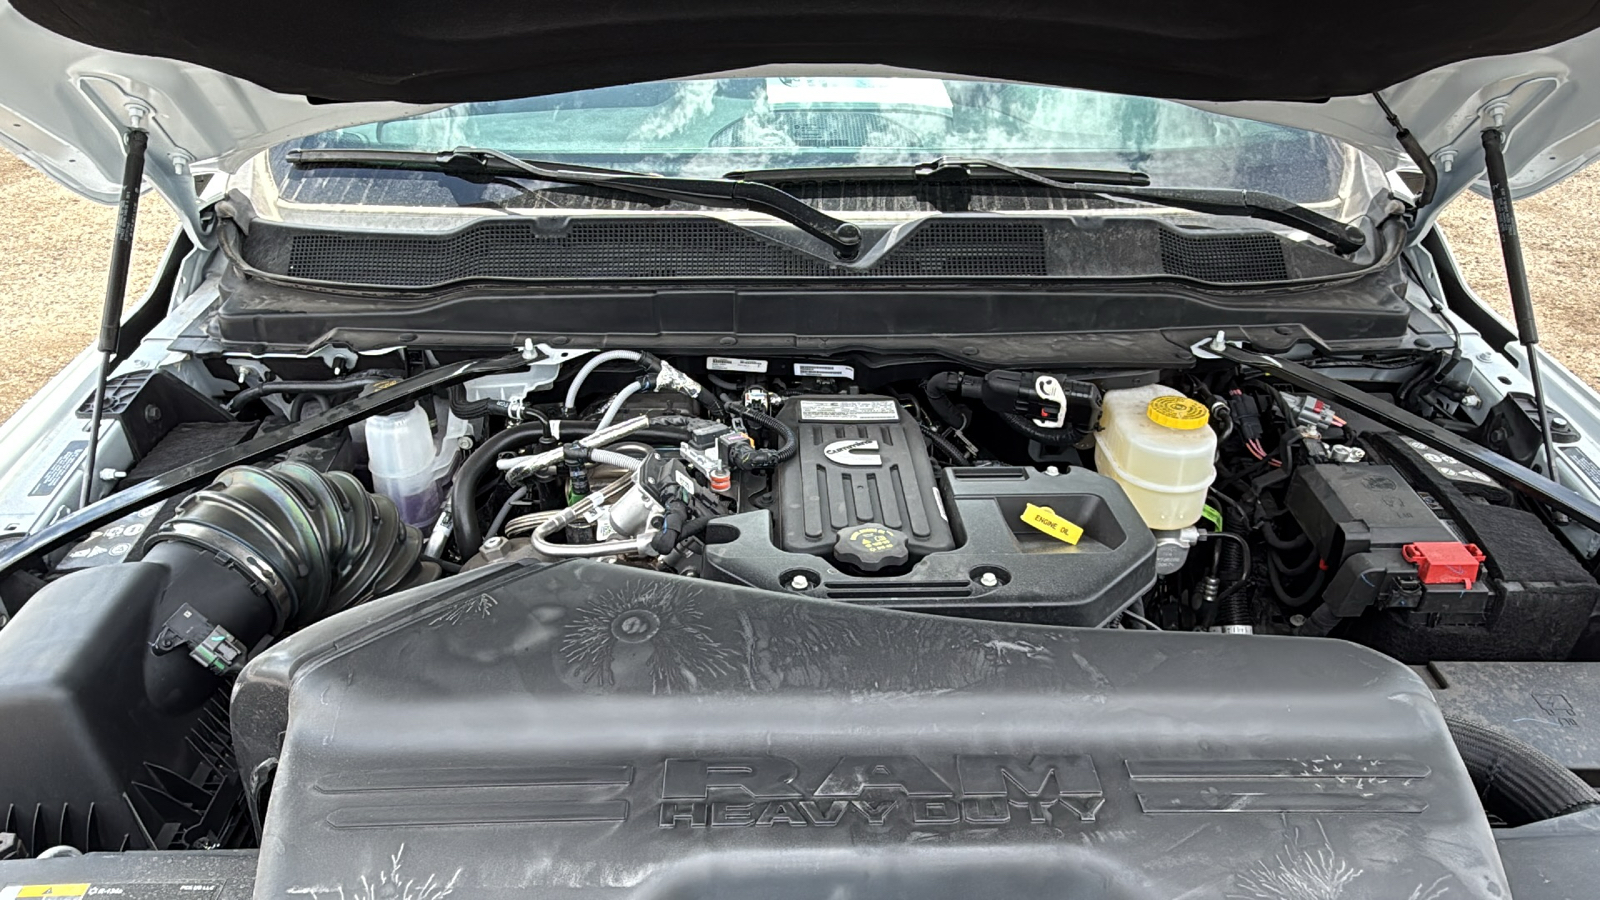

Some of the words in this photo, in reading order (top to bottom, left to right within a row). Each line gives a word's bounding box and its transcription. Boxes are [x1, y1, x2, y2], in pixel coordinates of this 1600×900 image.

[825, 440, 873, 455] Cummins
[1034, 514, 1058, 530] ENGINE
[1059, 526, 1070, 536] OIL
[661, 754, 1104, 800] RAM
[659, 799, 898, 829] HEAVY
[912, 798, 1106, 825] DUTY
